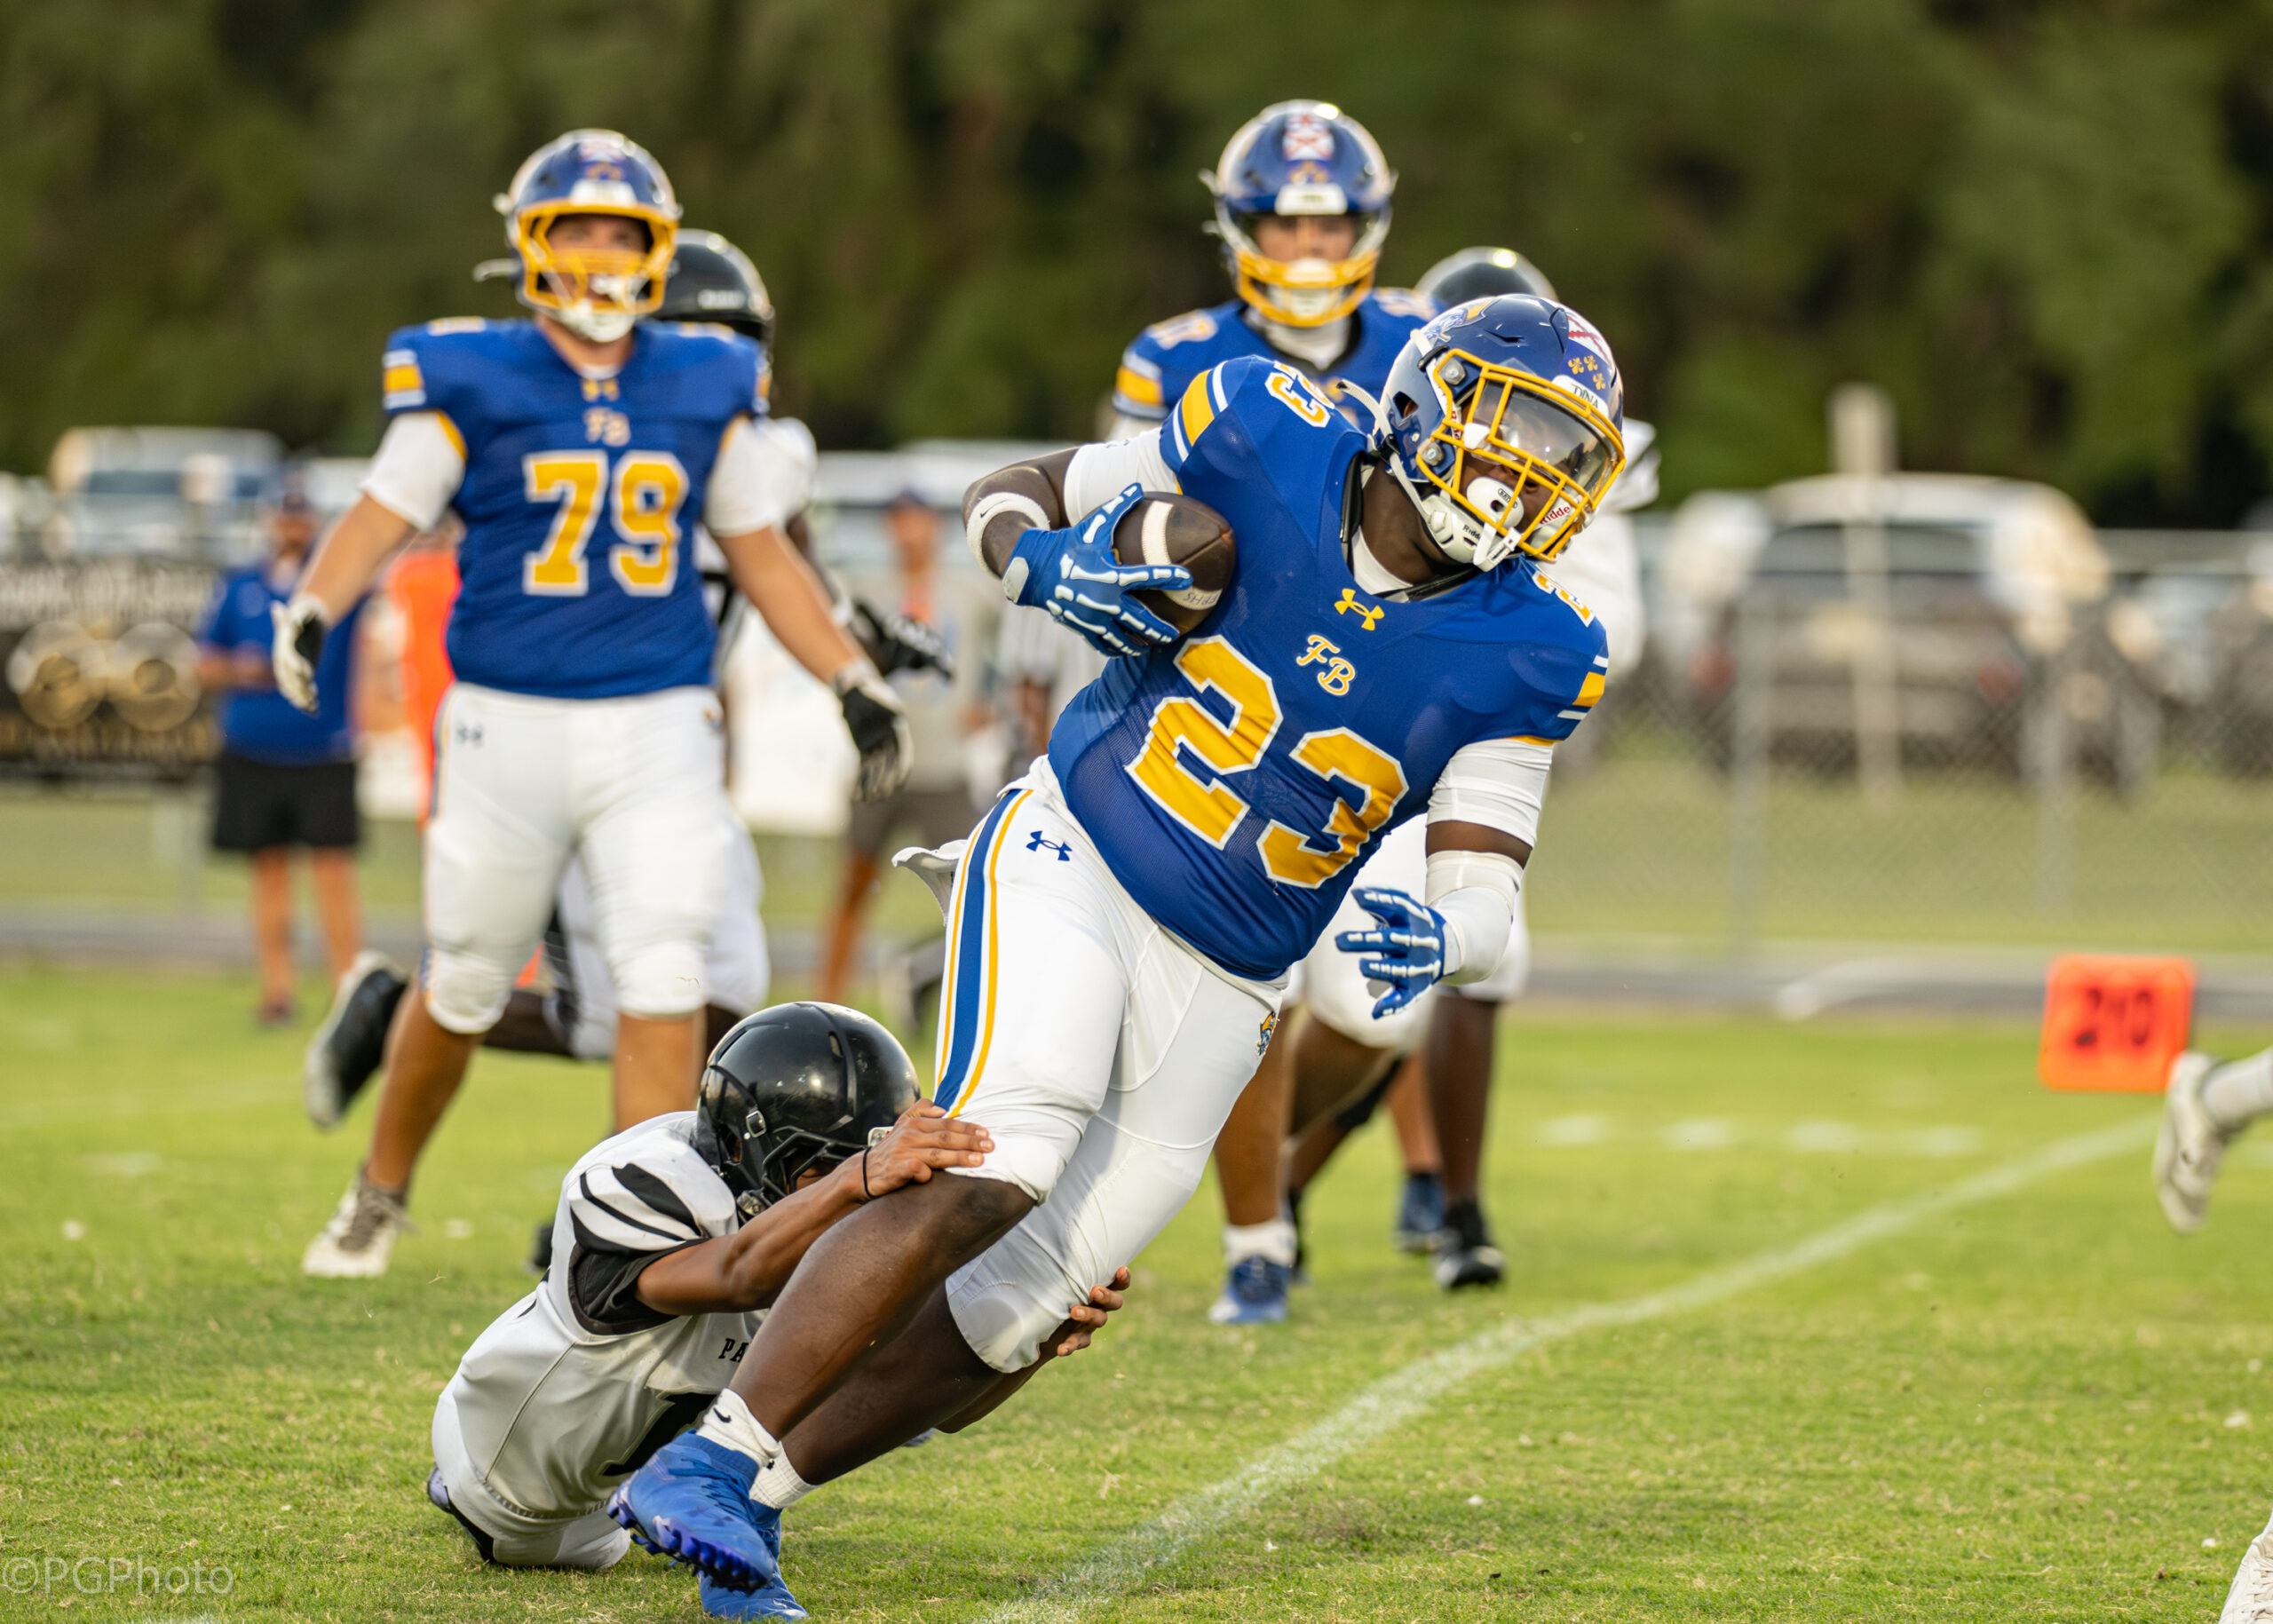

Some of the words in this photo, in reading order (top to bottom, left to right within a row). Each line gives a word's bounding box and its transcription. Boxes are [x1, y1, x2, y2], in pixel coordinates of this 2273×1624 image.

[522, 449, 689, 597] 79
[1296, 634, 1356, 696] FB
[1122, 634, 1410, 890] 23
